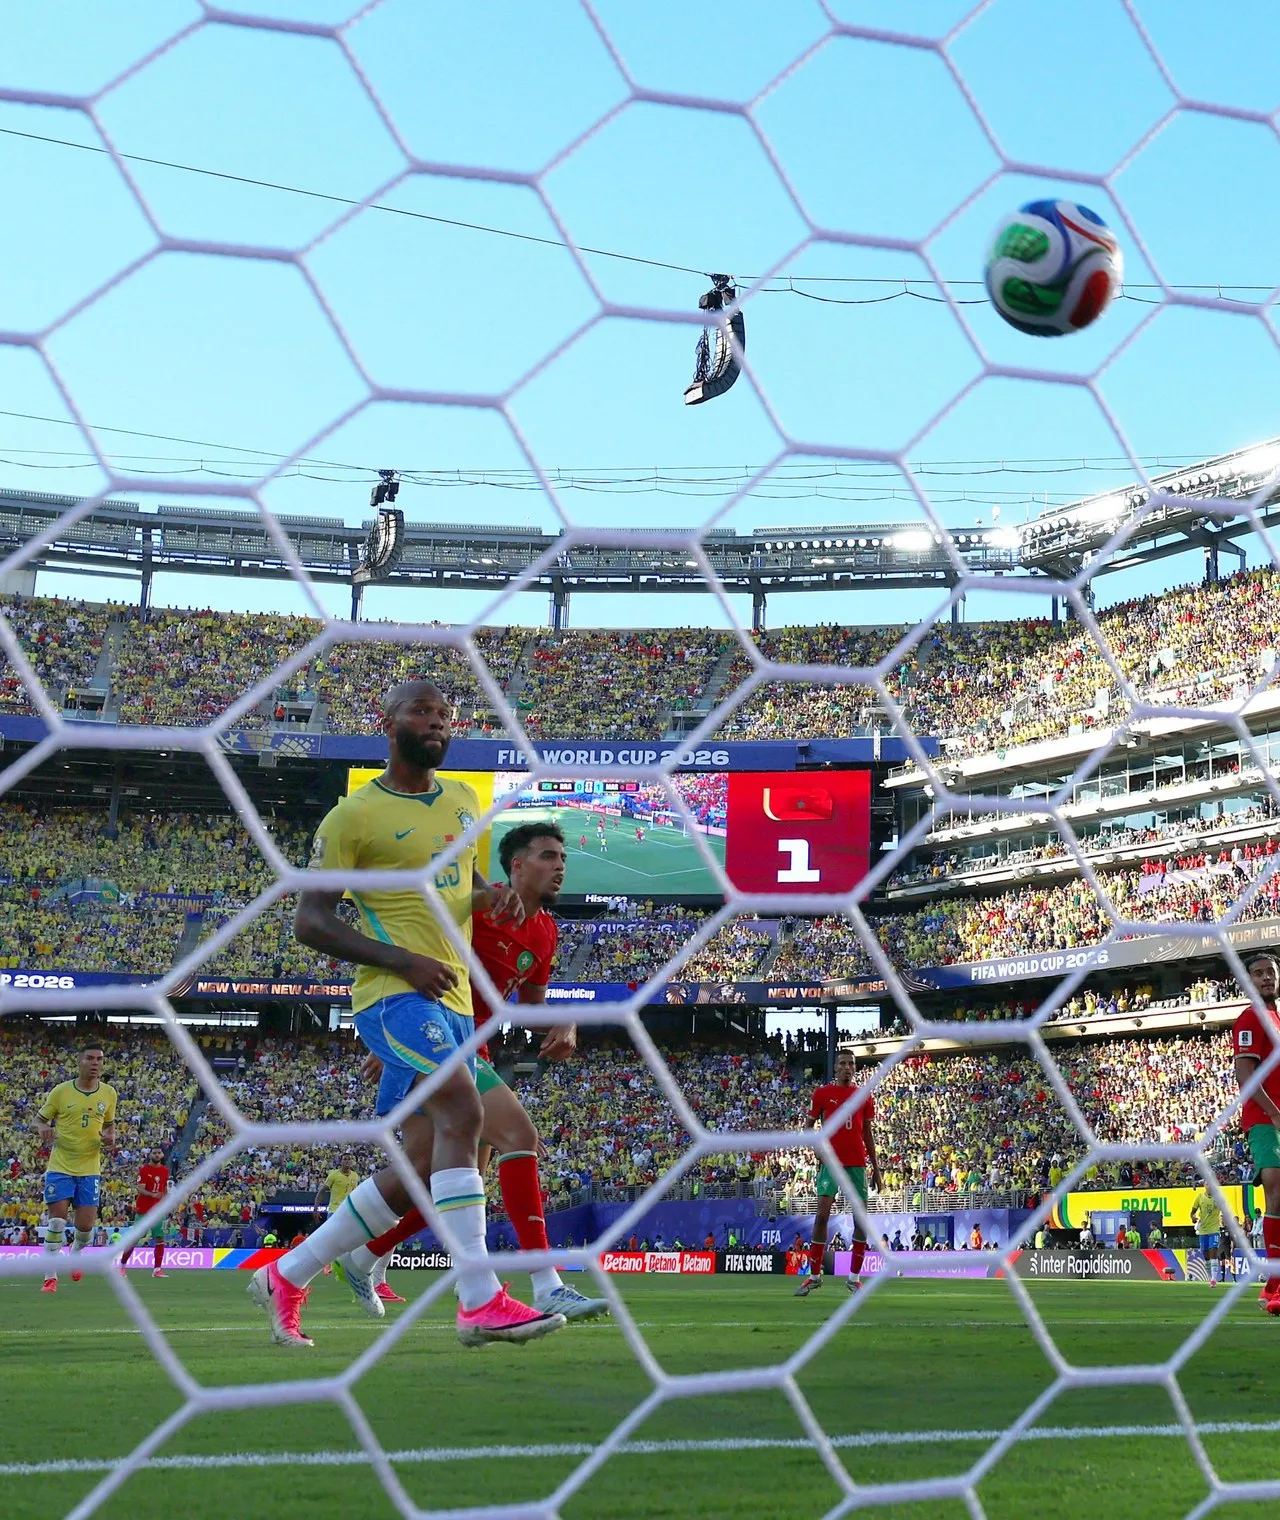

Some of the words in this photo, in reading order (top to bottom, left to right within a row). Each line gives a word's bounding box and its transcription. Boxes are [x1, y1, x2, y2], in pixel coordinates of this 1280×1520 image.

[543, 749, 616, 765] WORLD
[617, 750, 657, 765] CUP
[660, 750, 730, 766] 2026
[777, 838, 821, 883] 1
[1229, 928, 1260, 945] YORK
[971, 965, 997, 981] FIFA
[997, 959, 1040, 977] WORLD
[1040, 954, 1065, 972] CUP
[13, 974, 74, 989] 2026
[197, 981, 230, 993] NEW
[231, 983, 270, 994] YORK
[271, 984, 303, 995] NEW
[768, 987, 798, 999] NEW
[834, 983, 855, 996] NEW
[81, 1114, 89, 1128] 5
[1121, 1197, 1172, 1217] BRAZIL
[761, 1230, 782, 1244] FIFA
[131, 1249, 204, 1267] krken
[390, 1252, 453, 1270] Rapidísi
[603, 1254, 642, 1271] Betano
[649, 1254, 677, 1271] Betano
[683, 1255, 711, 1272] Betano
[725, 1255, 744, 1272] FIFA
[745, 1255, 773, 1272] STORE
[1040, 1255, 1069, 1275] Inter
[1071, 1253, 1132, 1279] Rapidísimo
